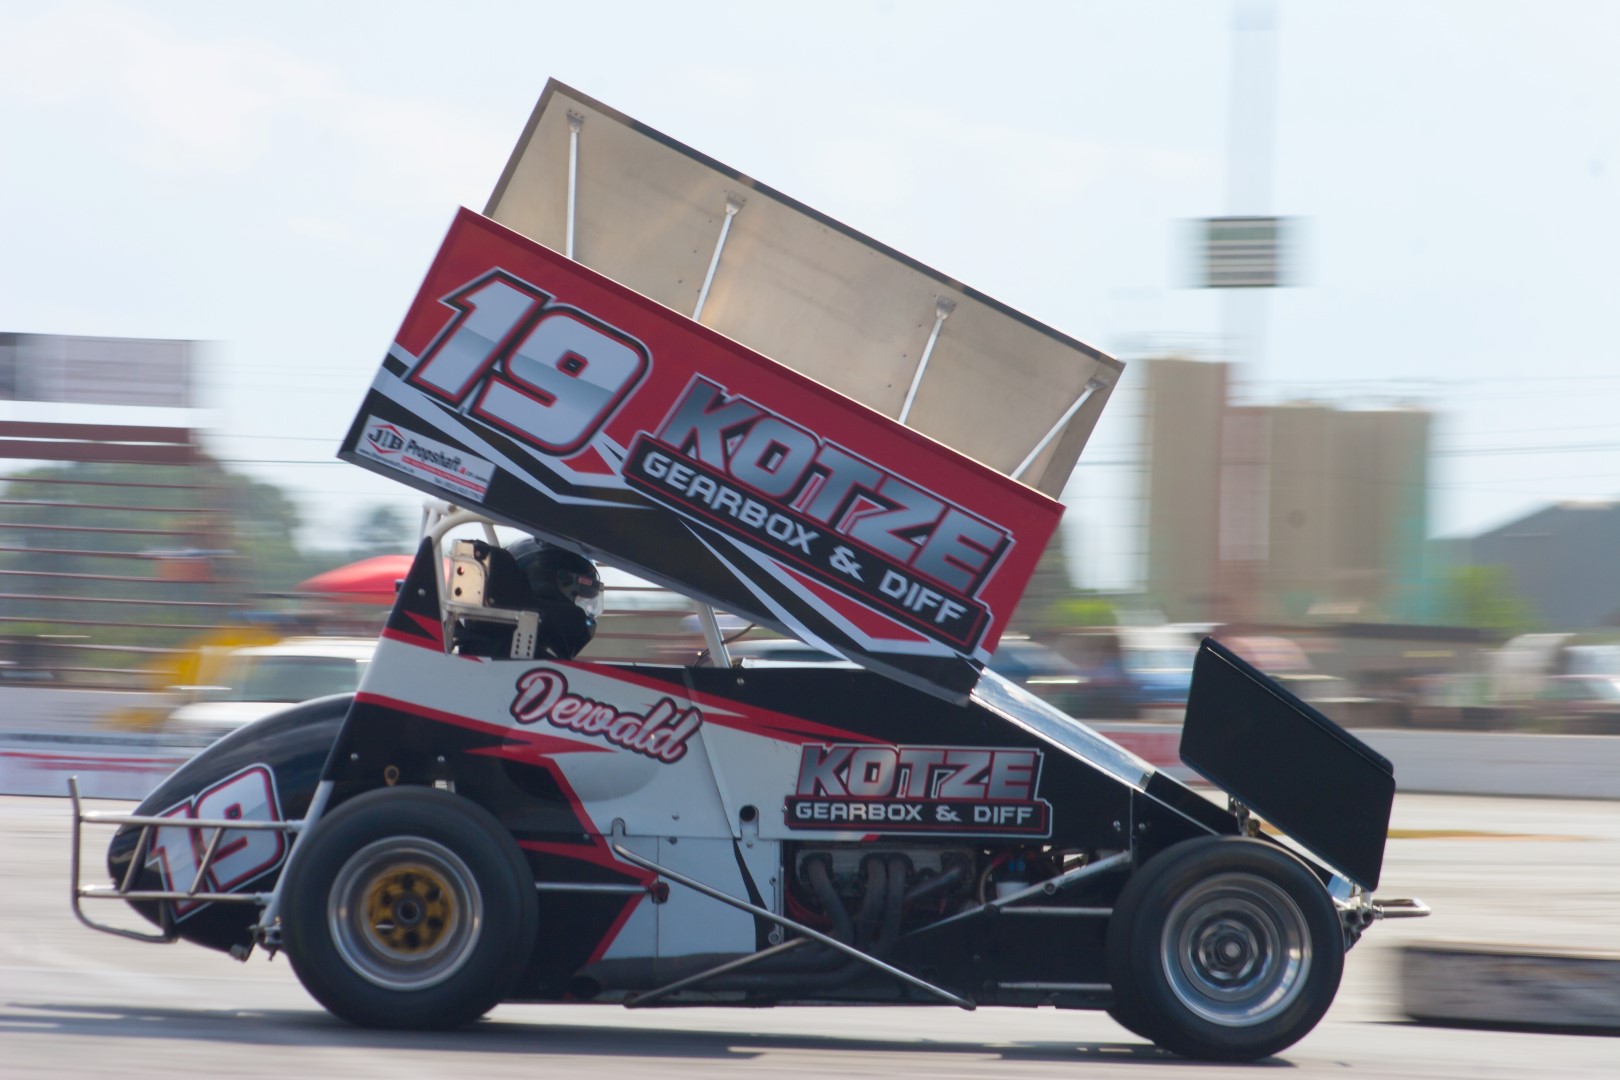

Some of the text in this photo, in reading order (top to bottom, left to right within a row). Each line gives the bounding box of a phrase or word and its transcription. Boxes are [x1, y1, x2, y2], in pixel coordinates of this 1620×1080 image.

[404, 268, 651, 456] 19
[642, 450, 967, 624] GEARBOX & DIFF
[657, 379, 1007, 592] KOTZE
[511, 669, 702, 762] Dewald
[797, 747, 1037, 800] KOTZE
[146, 763, 287, 922] 19
[795, 801, 1035, 825] GEARBOX & DIFF
